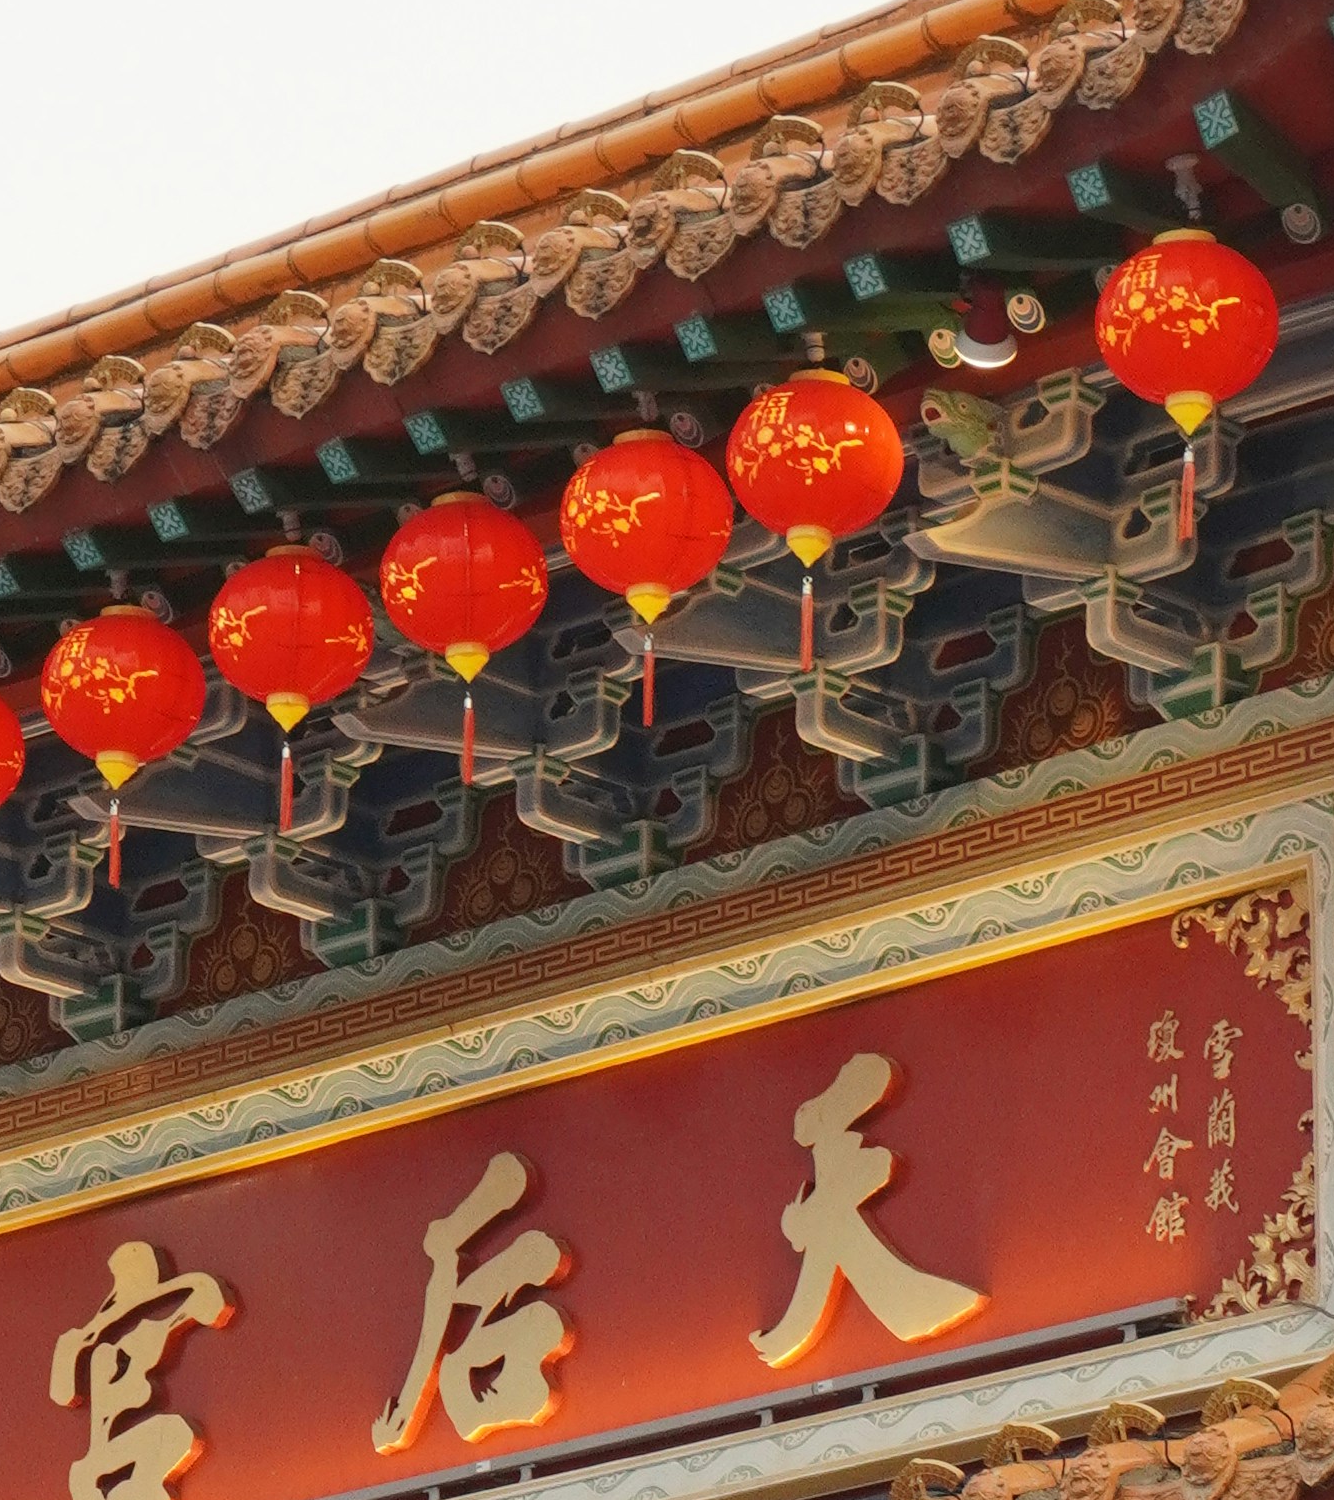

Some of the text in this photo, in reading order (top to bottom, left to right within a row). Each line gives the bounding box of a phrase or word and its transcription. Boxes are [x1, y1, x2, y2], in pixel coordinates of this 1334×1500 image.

[1116, 254, 1162, 296] 福
[749, 392, 794, 427] 福
[55, 628, 94, 663] 福
[1143, 1010, 1194, 1244] 瓊州會館
